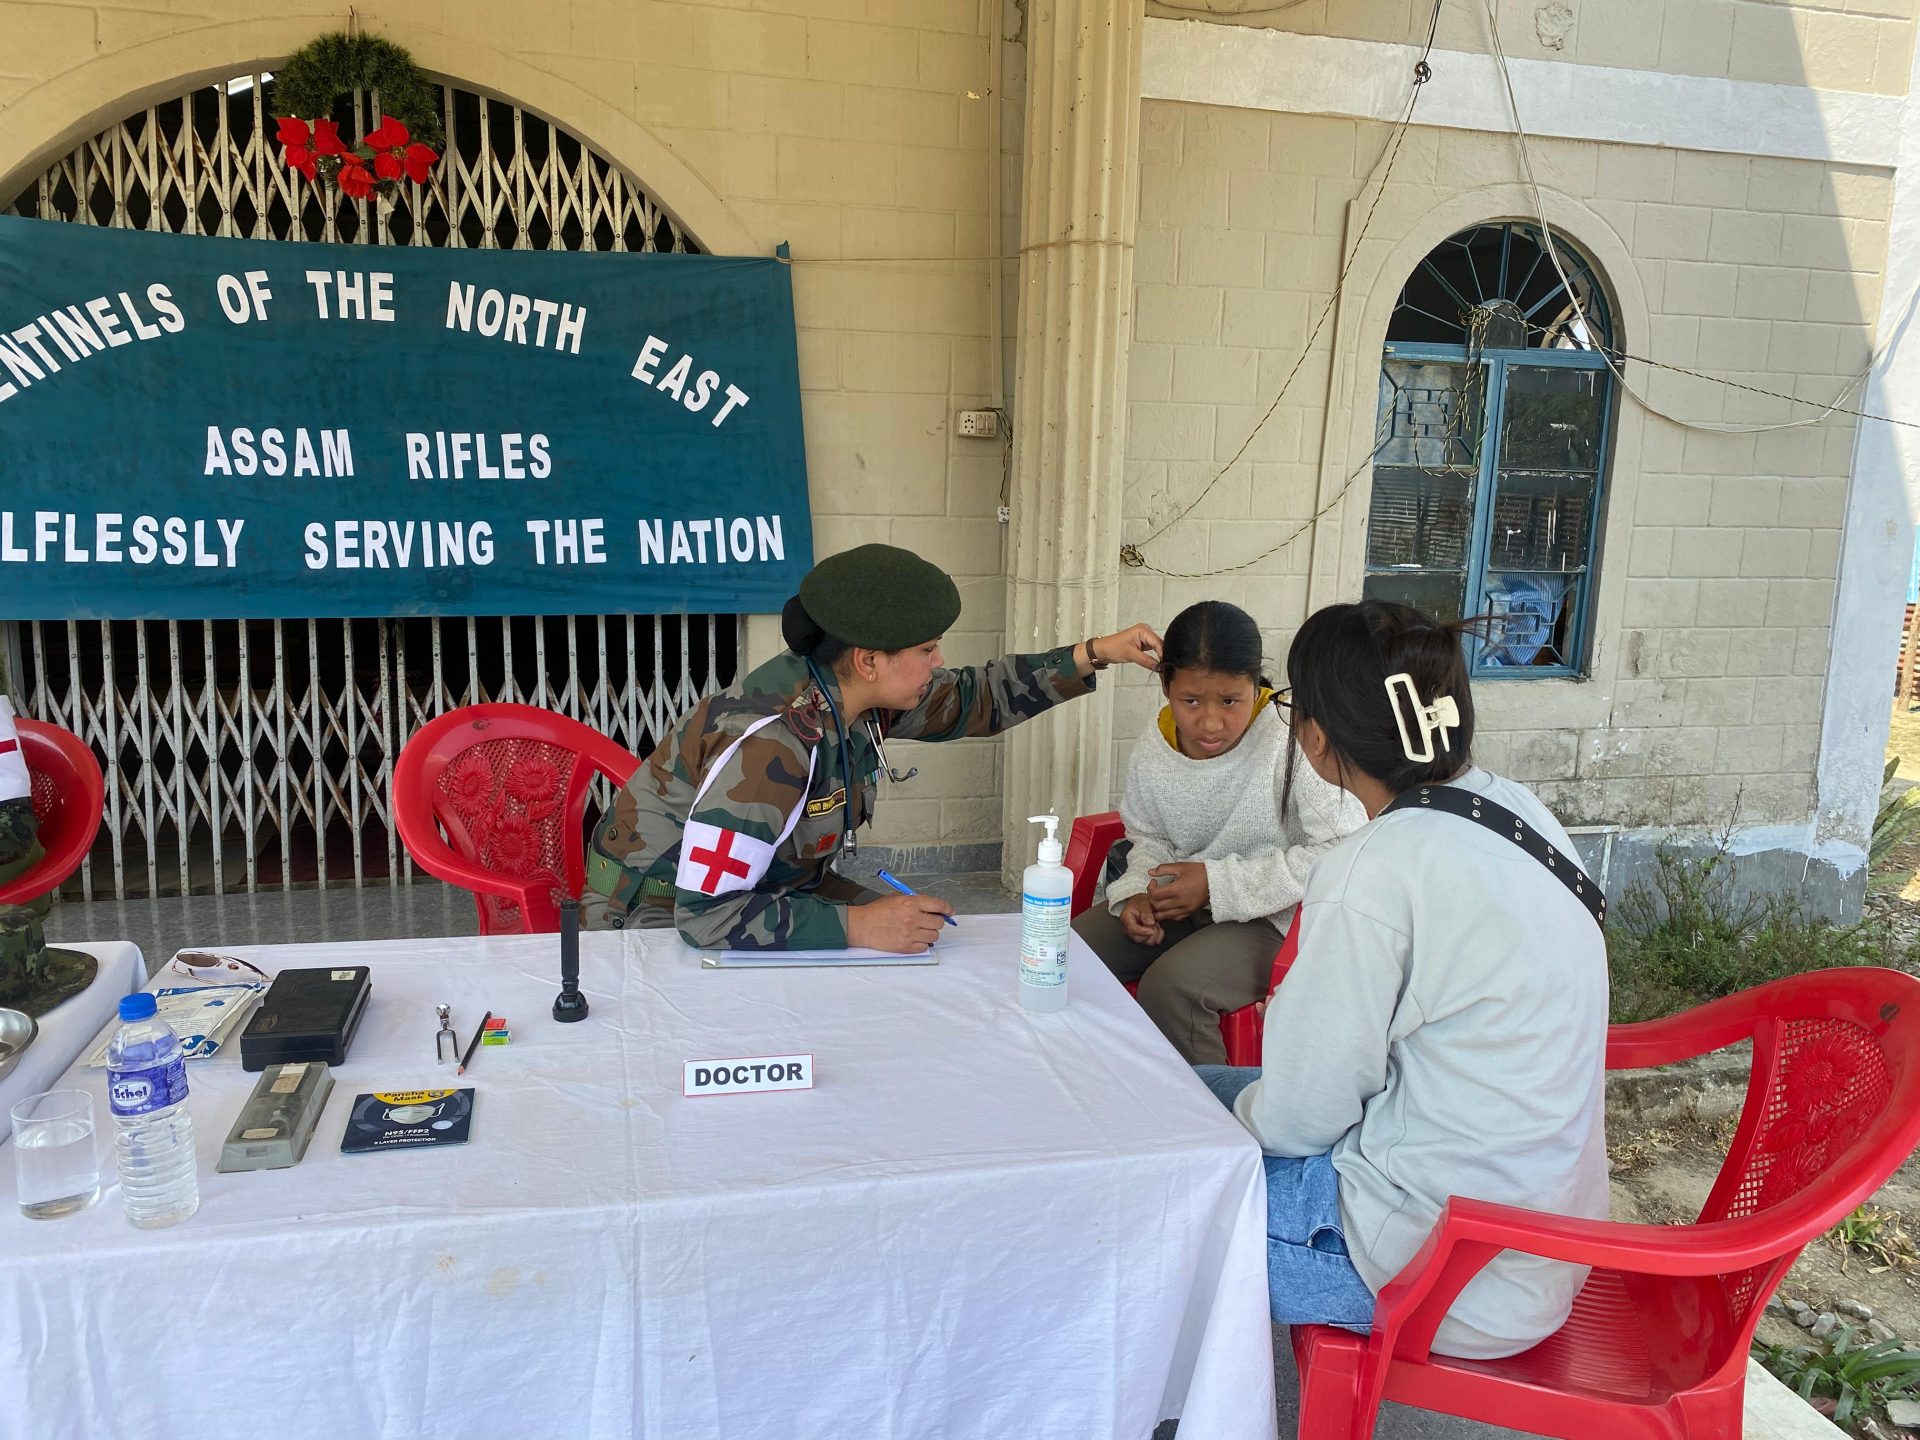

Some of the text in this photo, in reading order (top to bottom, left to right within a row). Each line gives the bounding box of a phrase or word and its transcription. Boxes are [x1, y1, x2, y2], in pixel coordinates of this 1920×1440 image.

[217, 271, 272, 323] OF
[306, 271, 394, 321] THE
[446, 281, 586, 354] NORTH
[631, 335, 749, 427] EAST
[204, 426, 551, 479] ASSAM RIFLES
[1, 512, 784, 569] LFLESSLY SERVING THE NATION
[695, 1063, 803, 1086] DOCTOR
[385, 1128, 429, 1136] N95/FFP2
